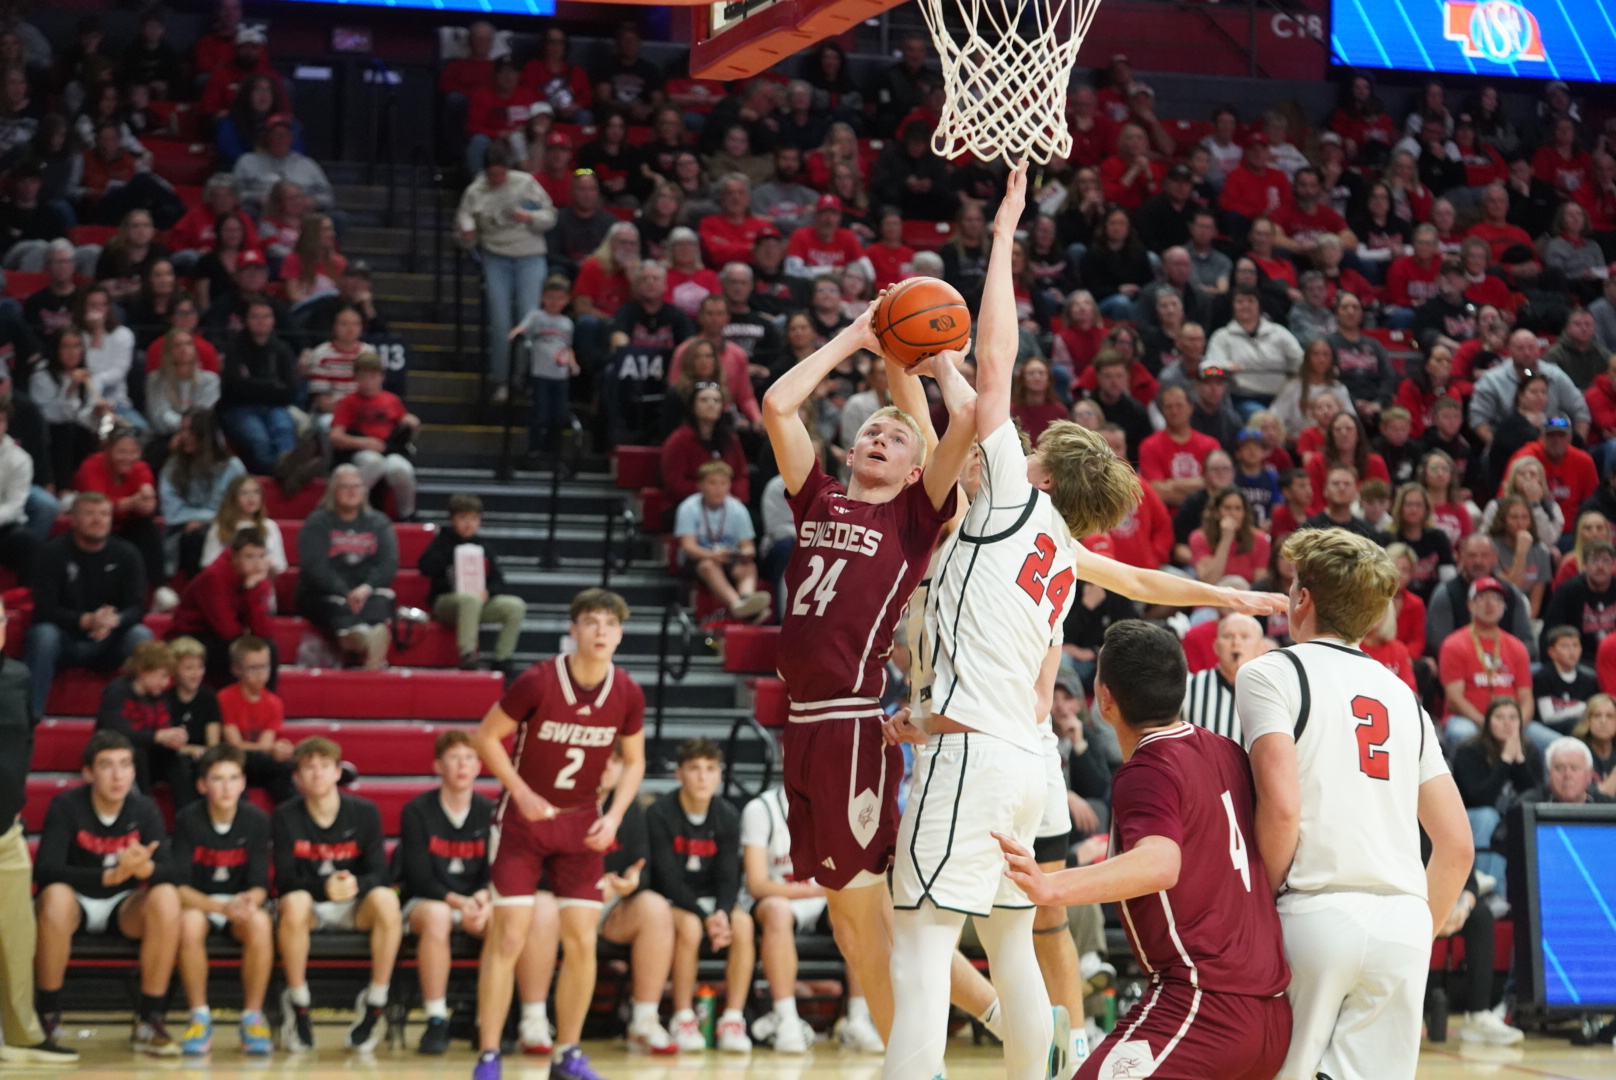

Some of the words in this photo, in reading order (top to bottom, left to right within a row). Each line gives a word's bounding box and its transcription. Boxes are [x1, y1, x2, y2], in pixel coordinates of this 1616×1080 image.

[1271, 13, 1323, 40] C18
[618, 354, 664, 380] A14
[799, 520, 883, 557] SWEDES
[791, 554, 848, 617] 24
[1015, 532, 1076, 634] 24
[537, 719, 618, 747] SWEDES
[1350, 694, 1390, 781] 2
[553, 747, 586, 790] 2
[1220, 789, 1252, 892] 4
